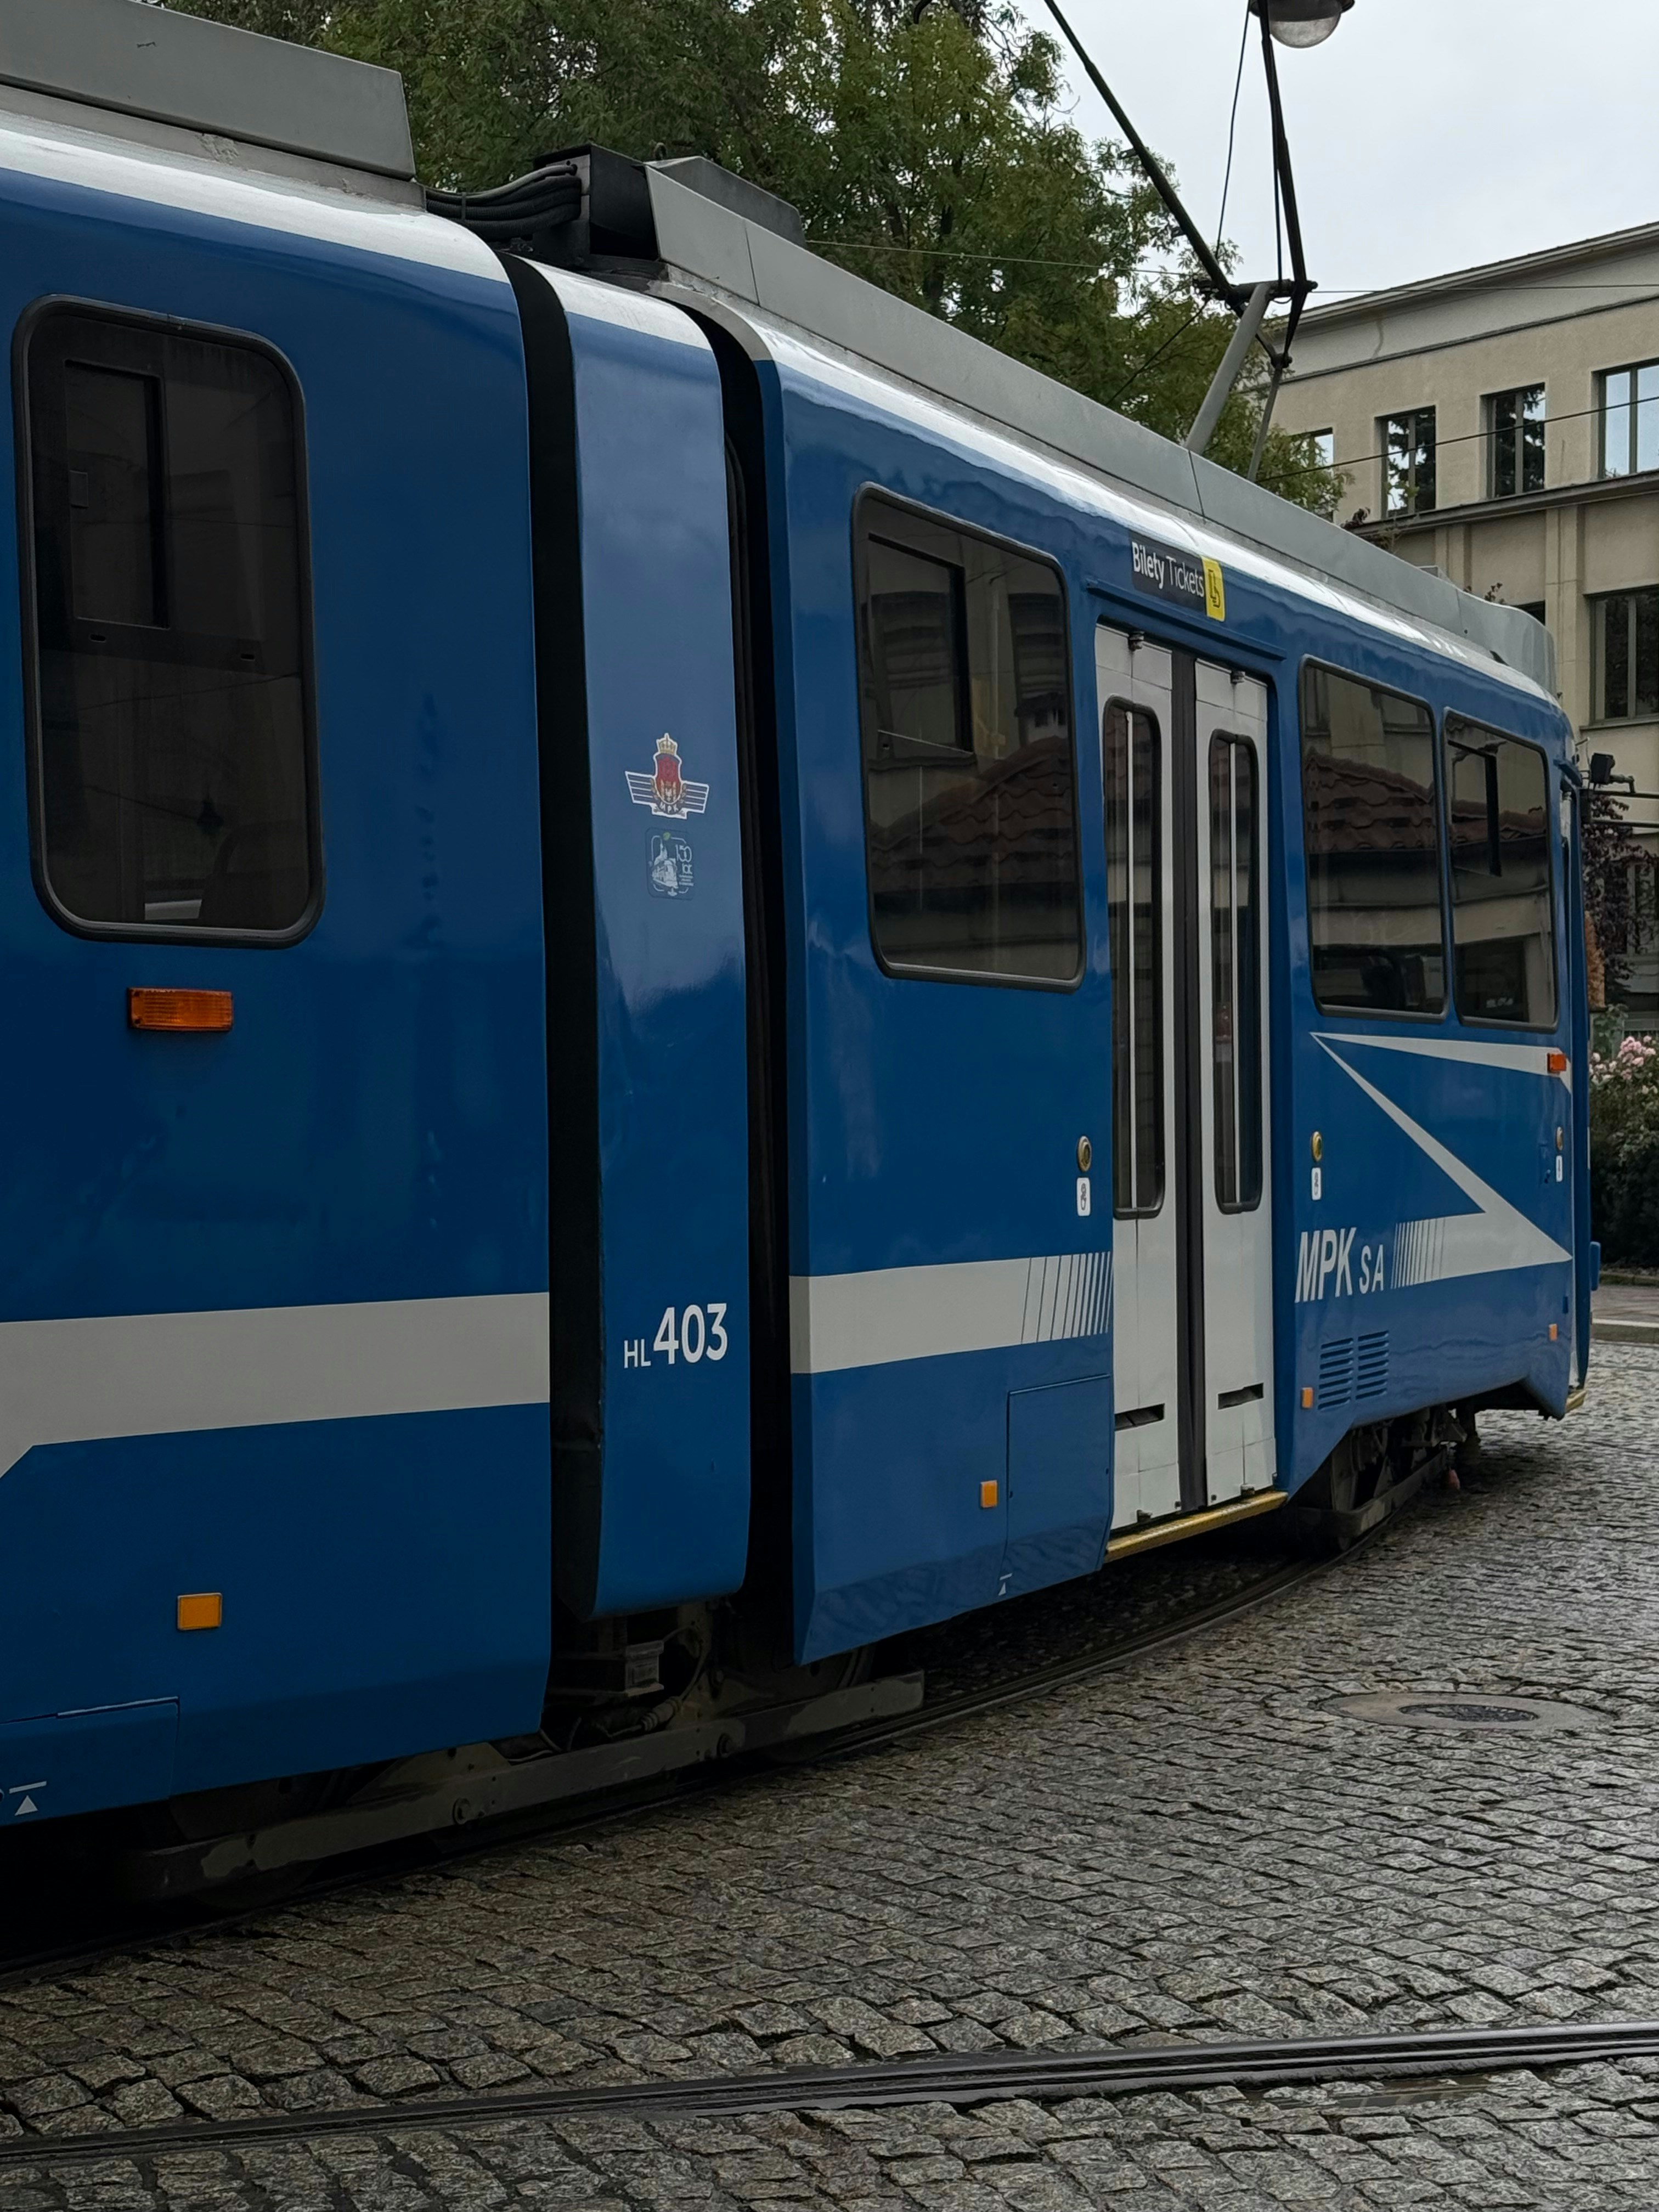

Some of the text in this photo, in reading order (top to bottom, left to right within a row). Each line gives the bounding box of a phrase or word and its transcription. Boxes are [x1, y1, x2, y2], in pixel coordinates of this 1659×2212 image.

[1131, 541, 1205, 597] Bilety Tickets
[659, 802, 679, 814] MPK
[1294, 1227, 1384, 1304] MPK SA
[624, 1303, 727, 1368] HL 403
